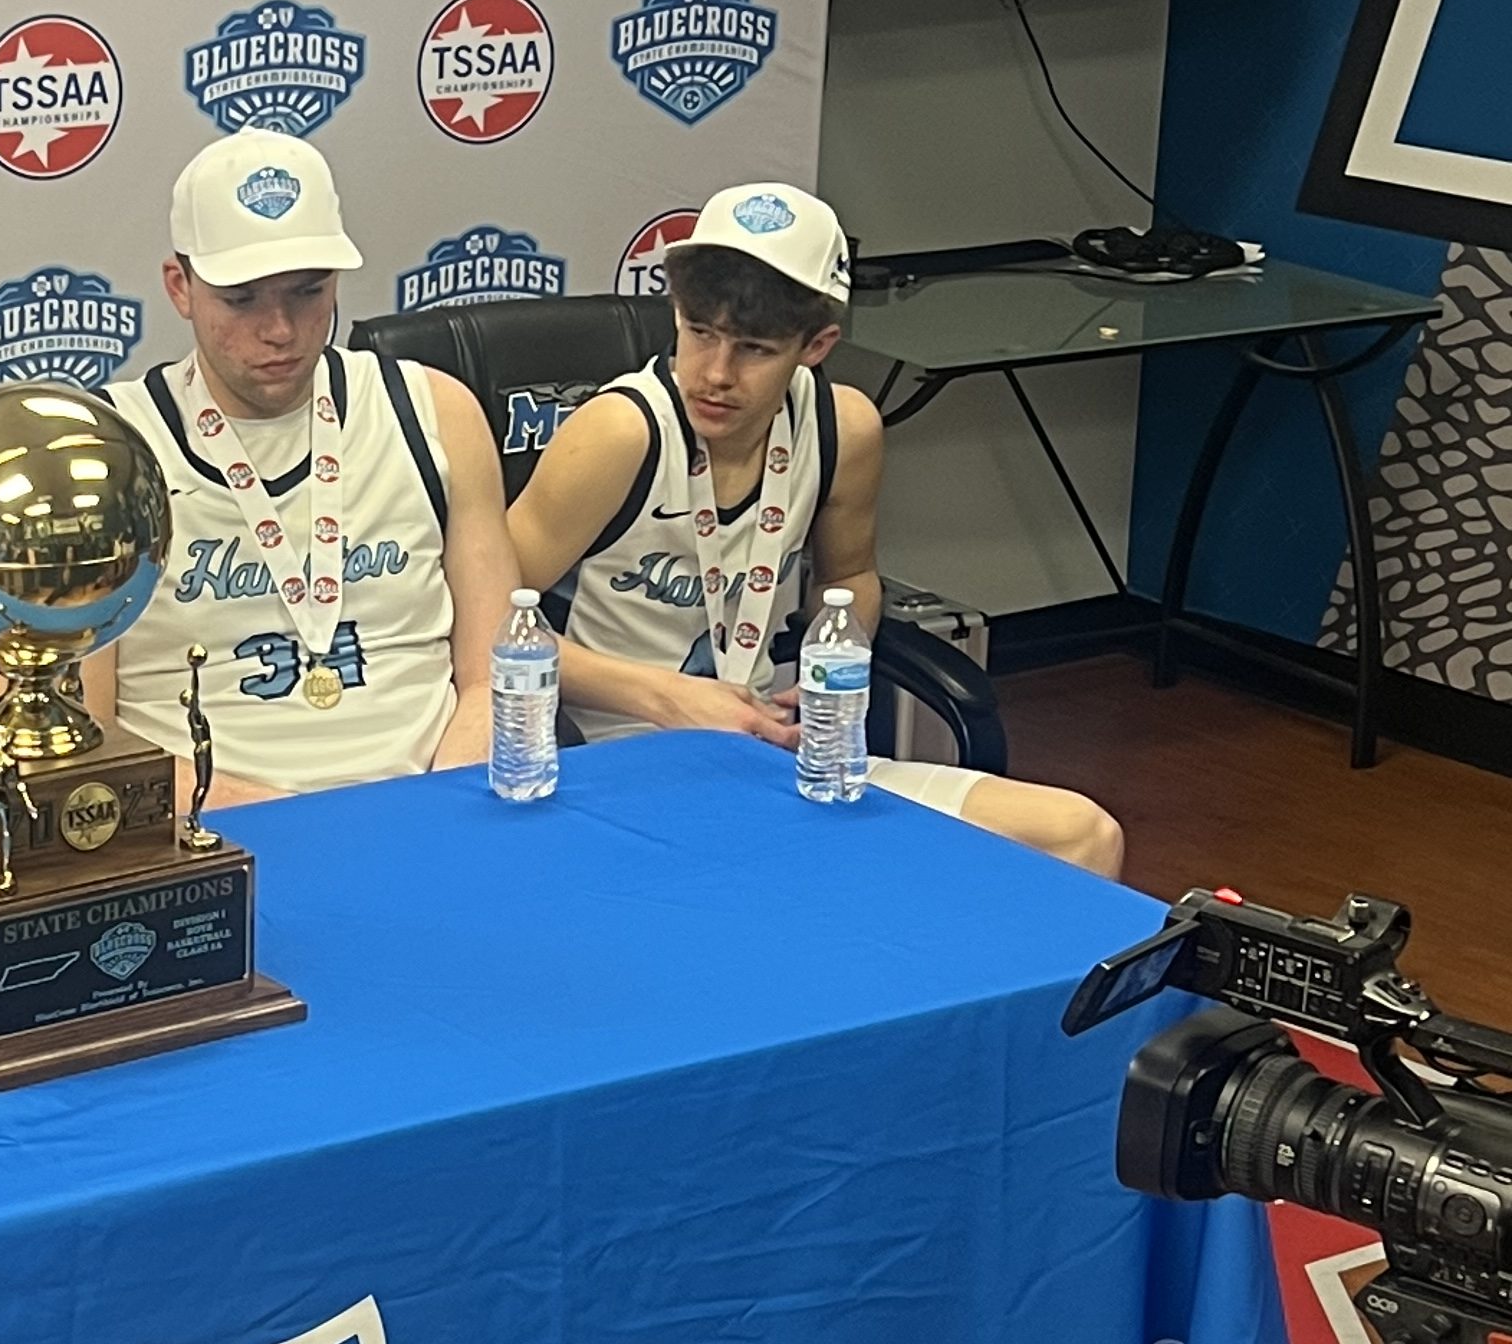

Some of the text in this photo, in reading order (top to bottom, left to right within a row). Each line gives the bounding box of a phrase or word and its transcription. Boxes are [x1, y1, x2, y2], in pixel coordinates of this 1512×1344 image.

[618, 5, 770, 55] BLUECROSS
[192, 32, 358, 86] BLUECROSS
[432, 41, 541, 79] TSSAA
[633, 42, 754, 66] STATE CHAMPIONSHIPS
[209, 71, 341, 98] STATE CHAMPIONSHIPS
[436, 79, 533, 94] CHAMPIONSHIPS
[403, 256, 559, 310] BLUECROSS
[21, 337, 118, 353] CHAMPIONSHIPS
[4, 876, 234, 944] STATE CHAMPIONS
